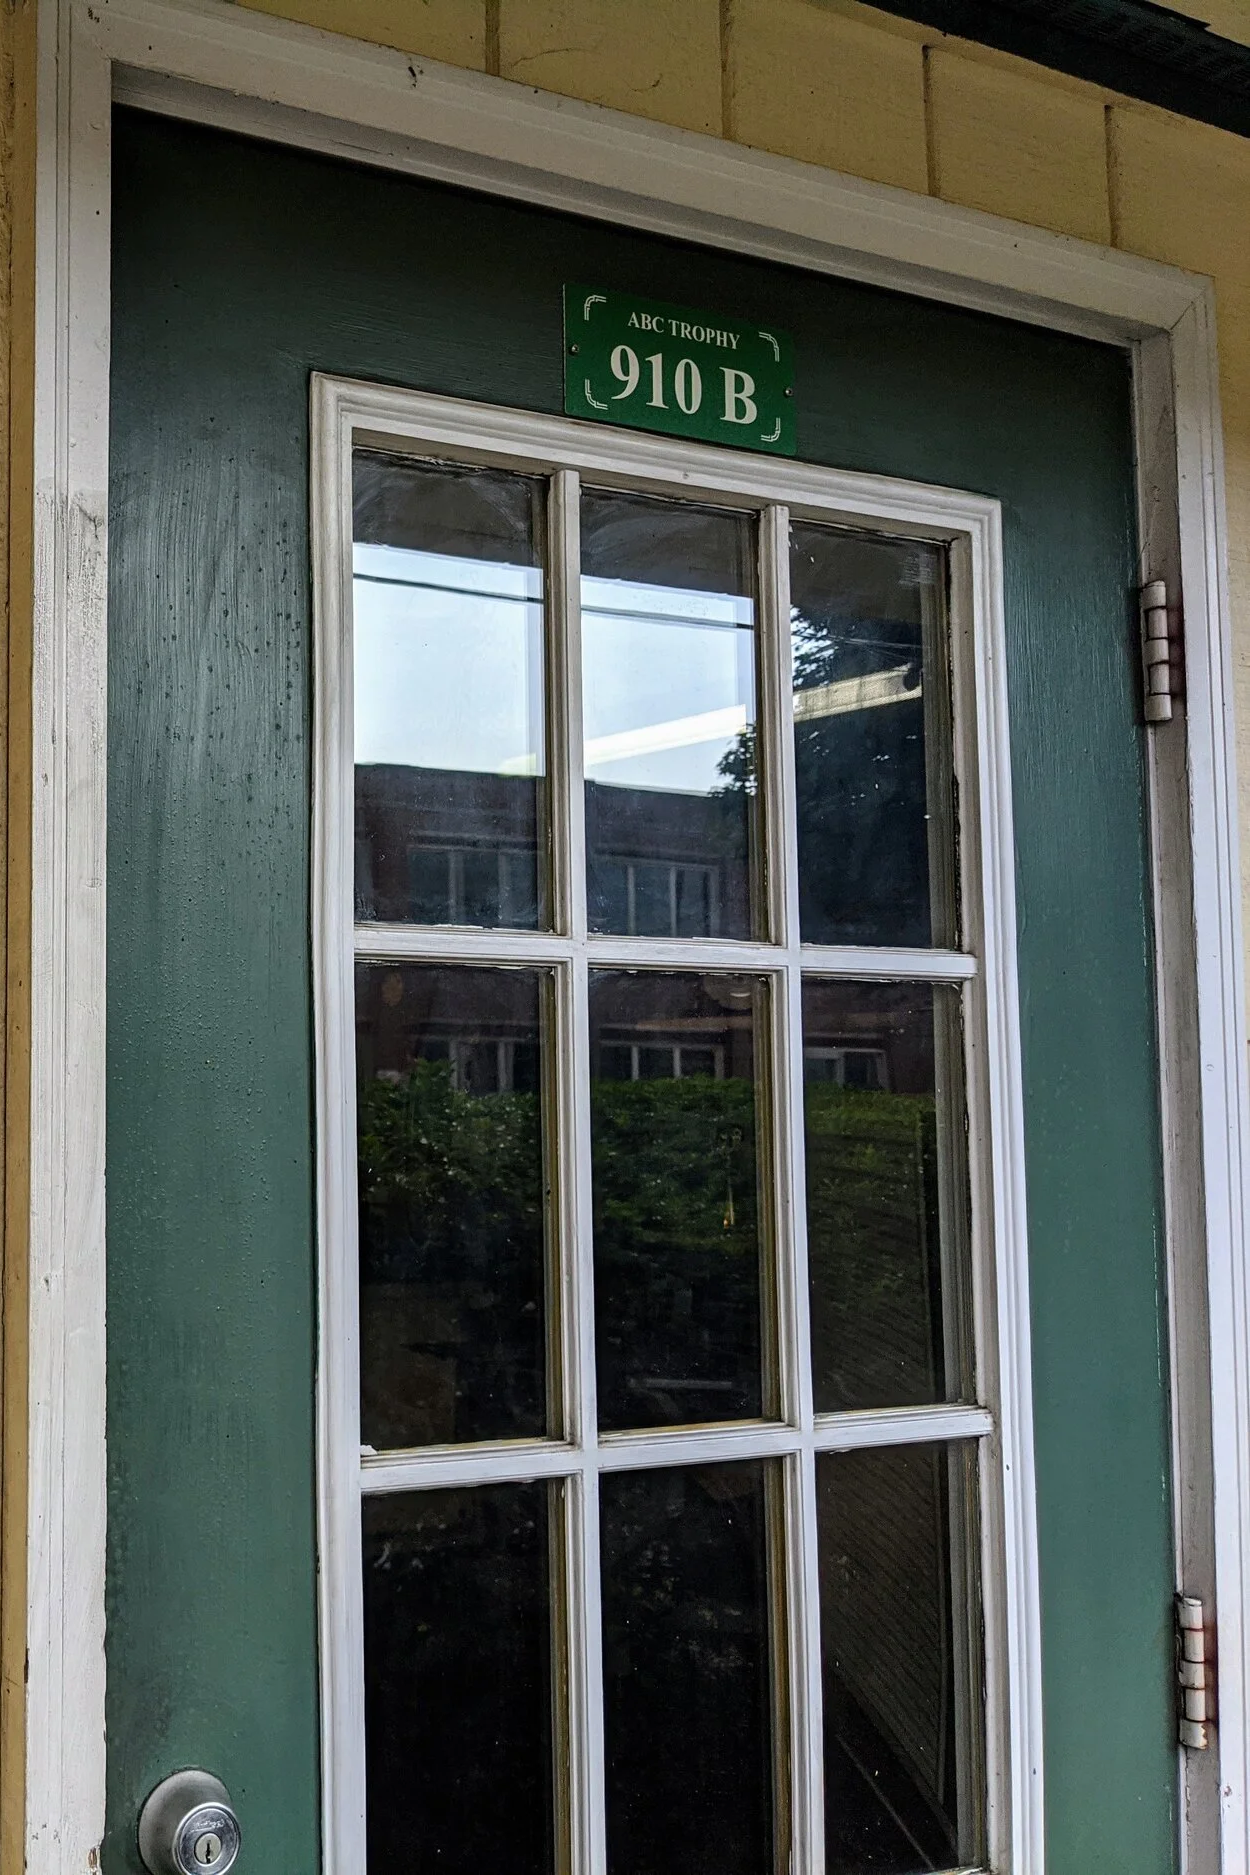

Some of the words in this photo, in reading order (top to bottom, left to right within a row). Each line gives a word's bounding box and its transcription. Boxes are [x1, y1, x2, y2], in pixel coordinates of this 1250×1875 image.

[627, 311, 665, 333] ABC
[668, 319, 741, 350] TROPHY
[610, 344, 702, 415] 910
[719, 366, 758, 425] B
